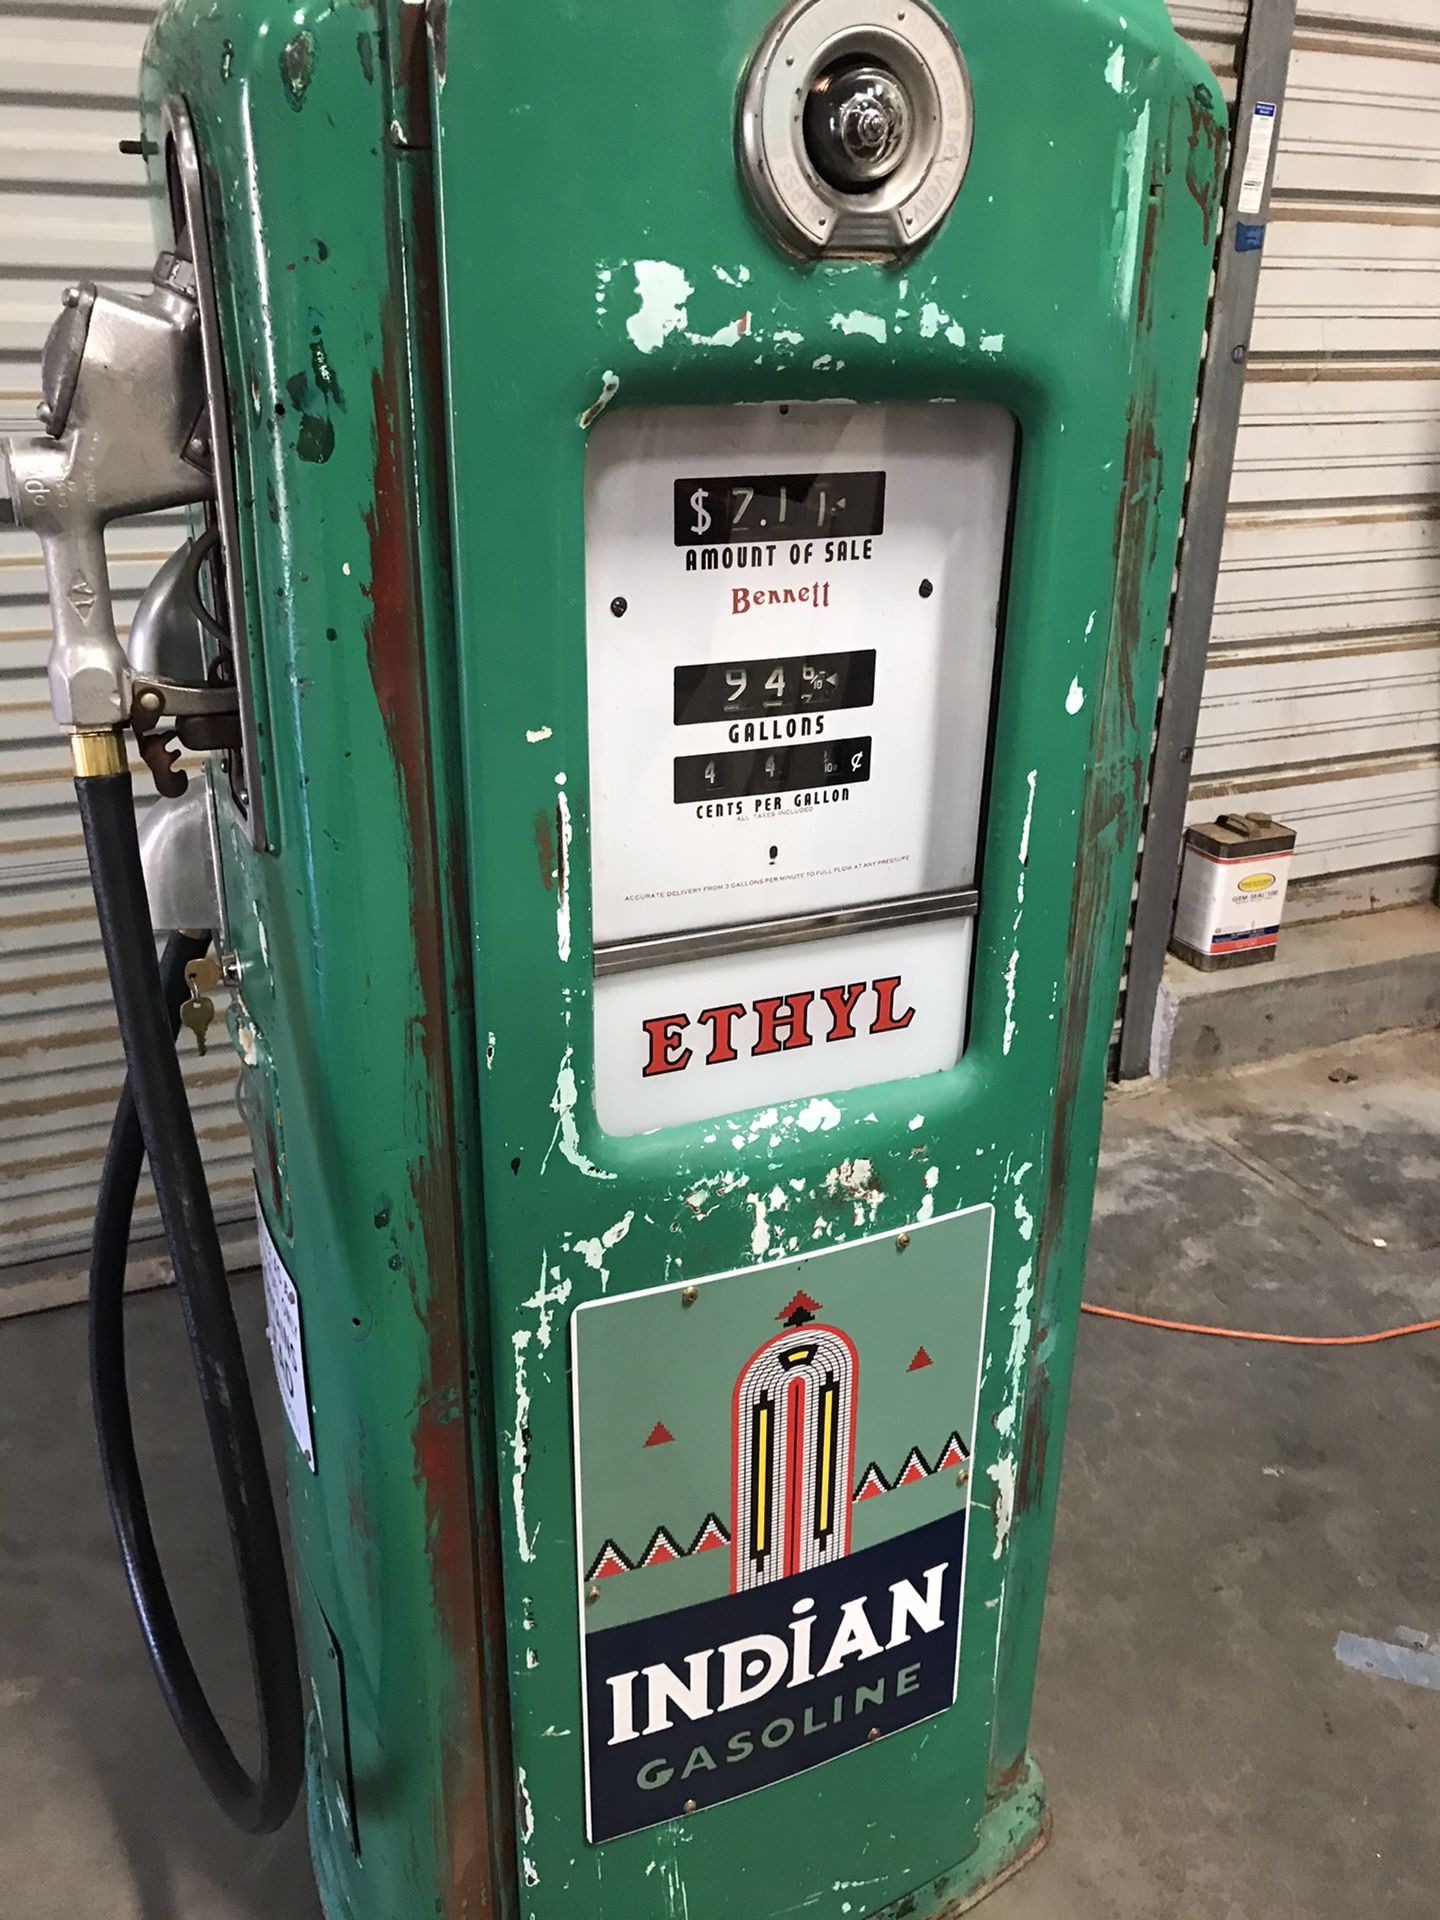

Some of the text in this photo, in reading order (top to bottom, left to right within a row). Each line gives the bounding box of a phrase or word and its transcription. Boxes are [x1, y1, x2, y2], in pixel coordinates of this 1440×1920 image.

[686, 539, 872, 571] AMOUNT OF SALE
[731, 581, 830, 615] Bennett
[728, 715, 824, 744] GALLONS
[696, 788, 849, 819] CENTS PER GALLON
[753, 811, 776, 819] TAXES
[778, 806, 814, 816] INCLUDED
[624, 890, 665, 902] ACCURATE
[666, 886, 702, 898] DELIVERY
[703, 883, 723, 892] FROM
[730, 877, 764, 889] GALLONS
[779, 872, 805, 881] MINUTE
[815, 867, 833, 876] FULL
[833, 865, 852, 873] FLOW
[863, 860, 877, 868] ANY
[642, 975, 916, 1077] ETHYL
[636, 1662, 921, 1791] GASOLINE
